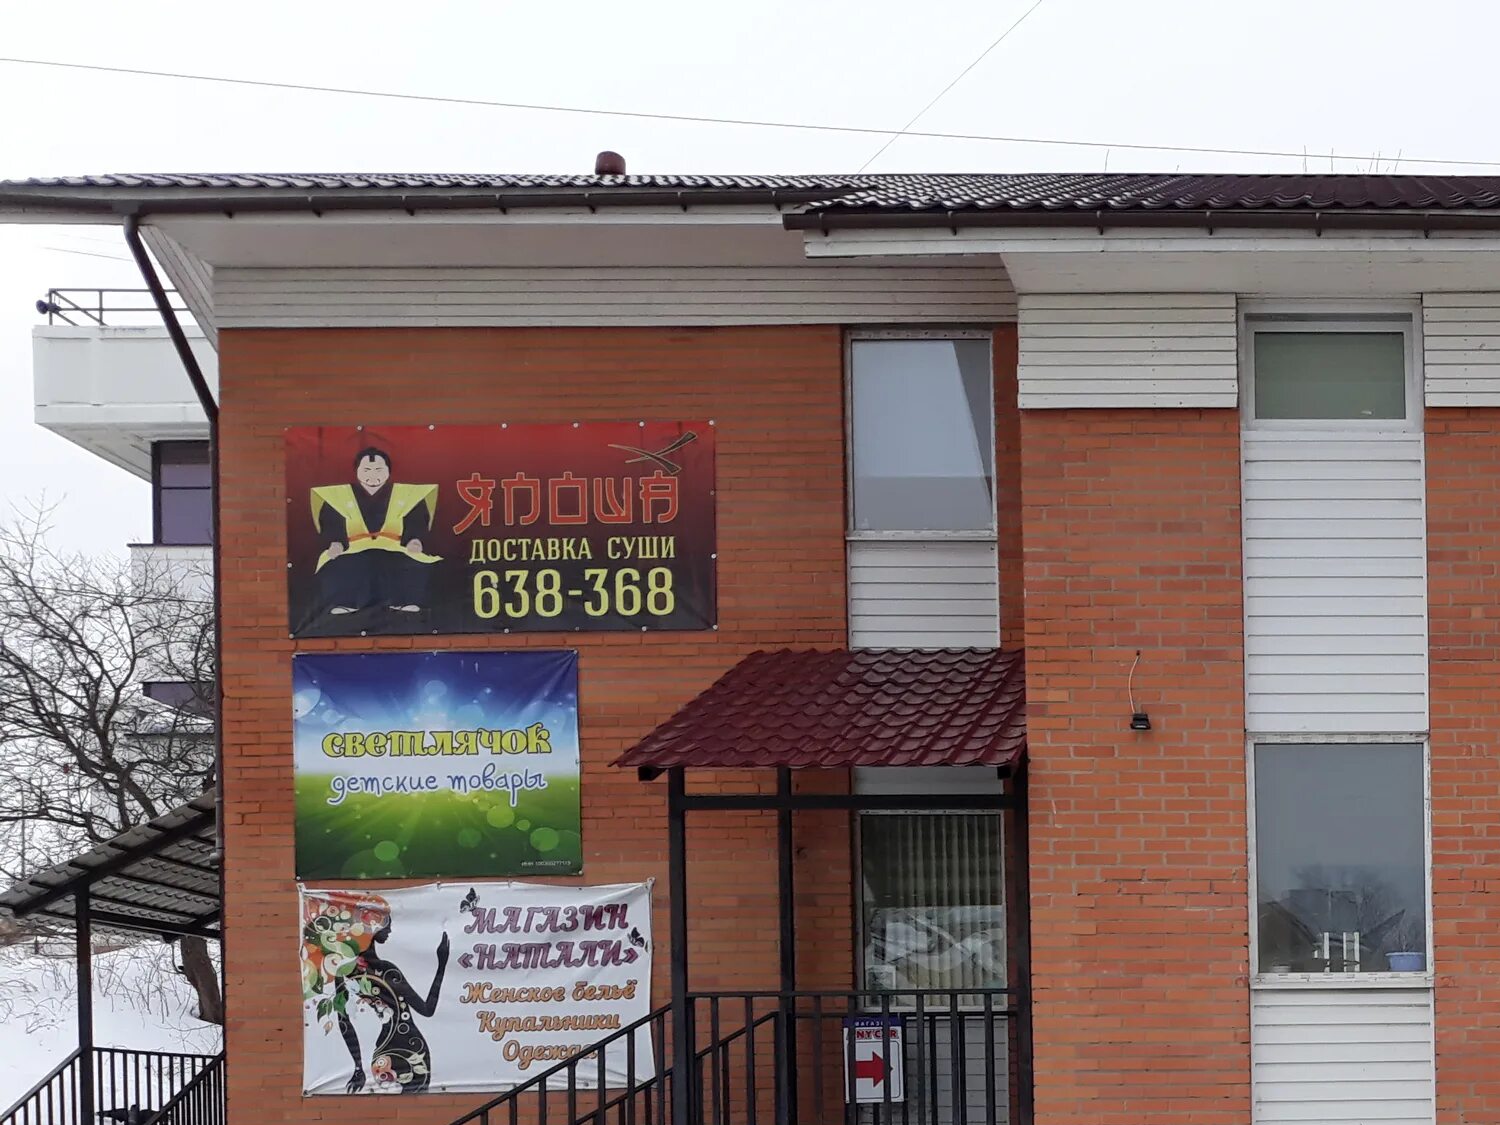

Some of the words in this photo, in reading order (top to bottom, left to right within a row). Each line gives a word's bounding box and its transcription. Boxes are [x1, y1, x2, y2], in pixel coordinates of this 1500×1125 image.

[453, 470, 679, 535] ЯПОША
[469, 537, 593, 564] ДОСТАВКА
[607, 536, 676, 560] СУШИ
[473, 567, 675, 619] 638-368
[322, 722, 552, 757] светлячок
[327, 774, 439, 806] детские
[447, 763, 547, 807] товары
[464, 903, 629, 934] МАГАЗИН
[457, 940, 639, 970] «НАТАЛИ»
[460, 982, 565, 1004] Женское
[571, 979, 638, 1000] бельё
[476, 1011, 621, 1041] Купальники
[873, 1029, 898, 1040] CR
